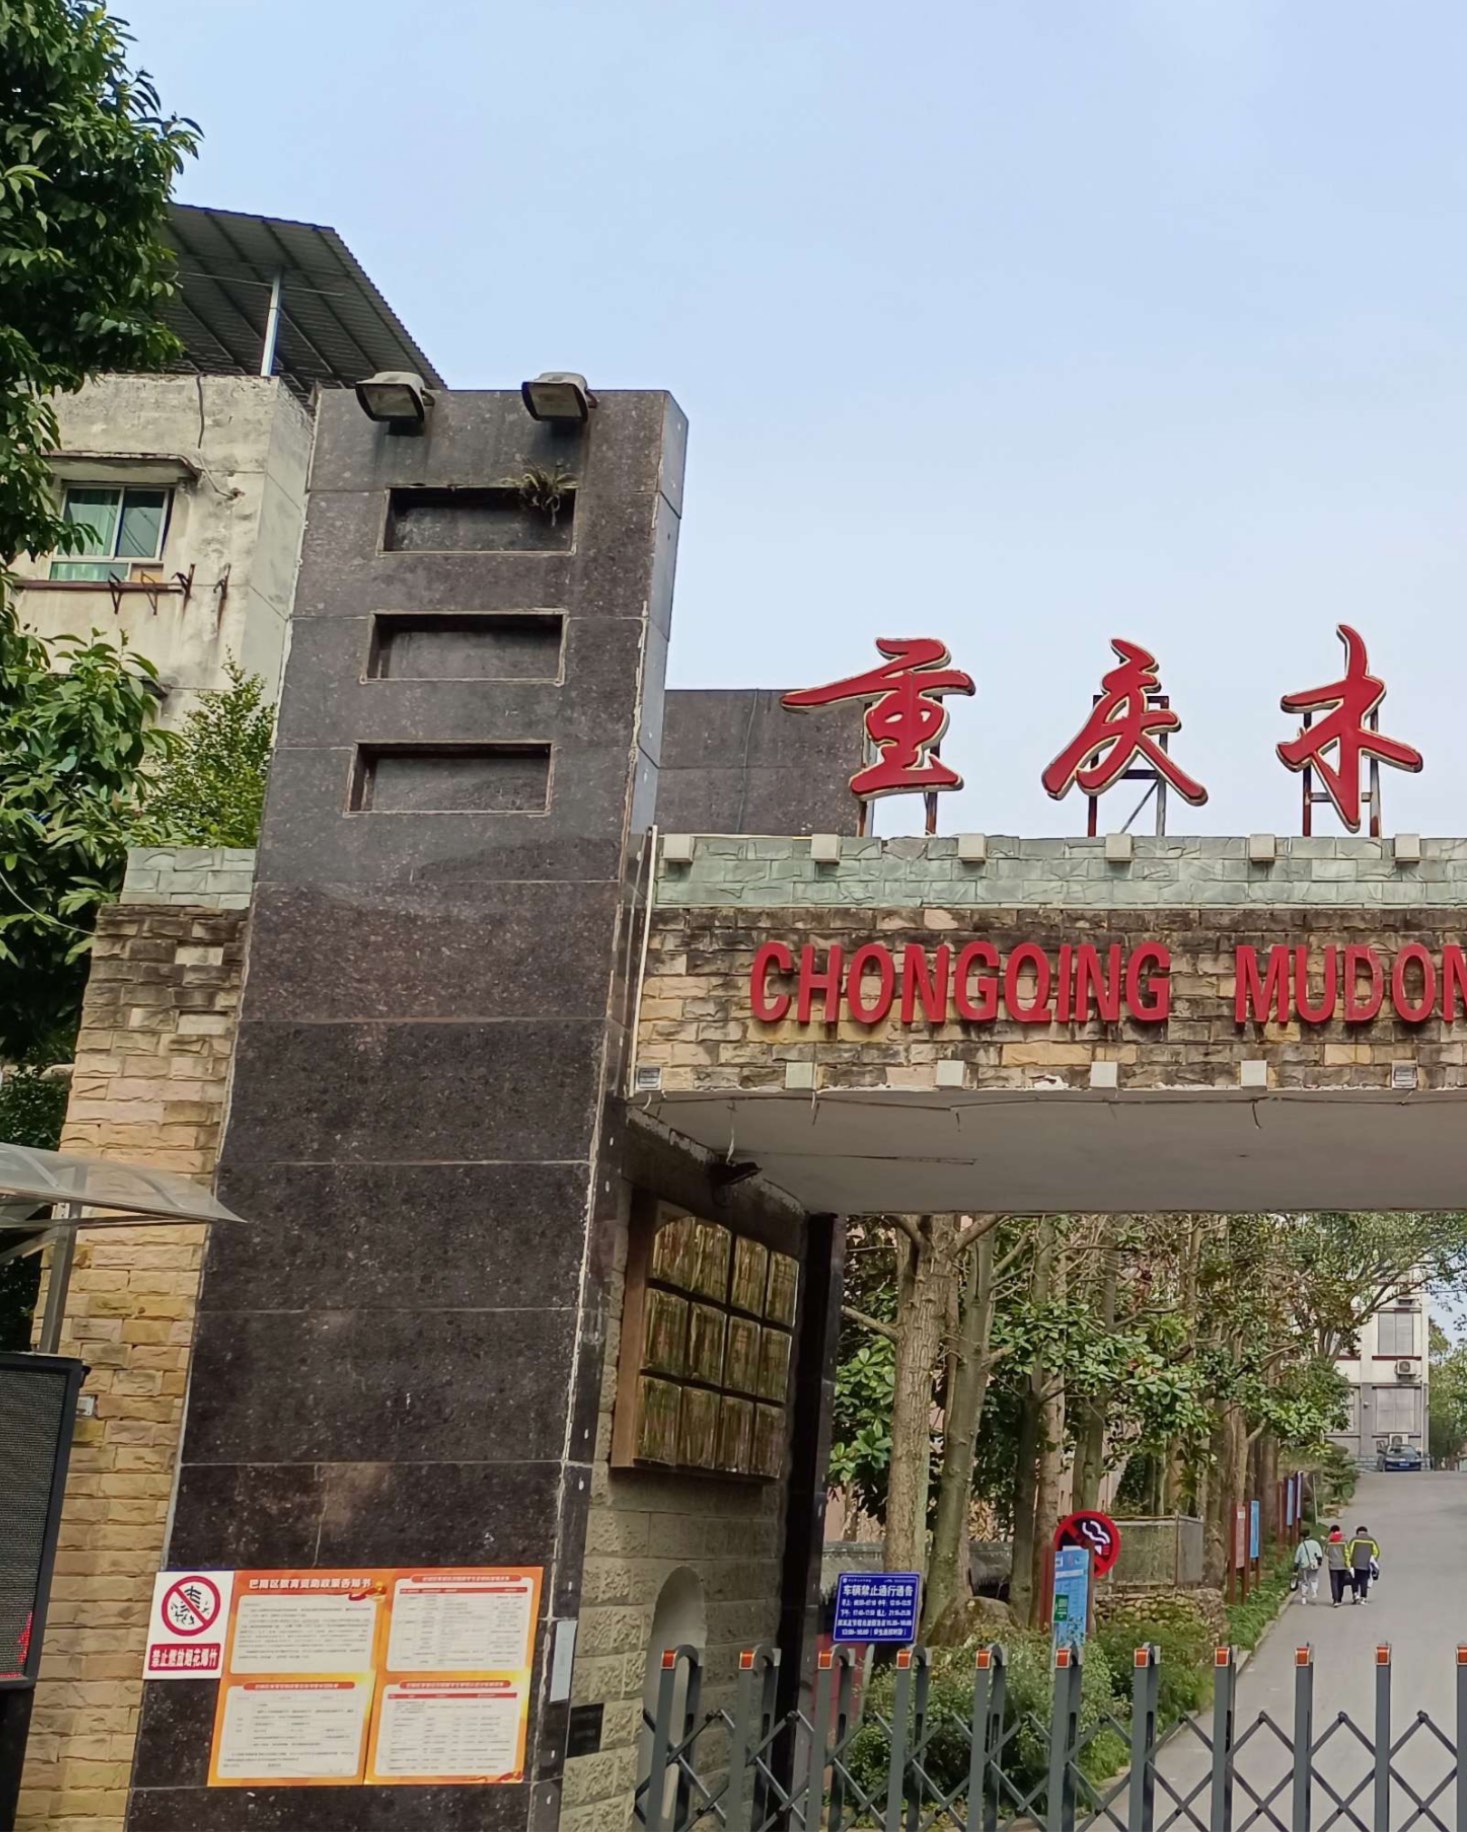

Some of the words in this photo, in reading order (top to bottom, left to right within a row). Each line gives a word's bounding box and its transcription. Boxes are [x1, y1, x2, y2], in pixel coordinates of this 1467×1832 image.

[749, 940, 1172, 1024] CHONGQING
[151, 1647, 218, 1668] 禁止燃放烟花爆竹
